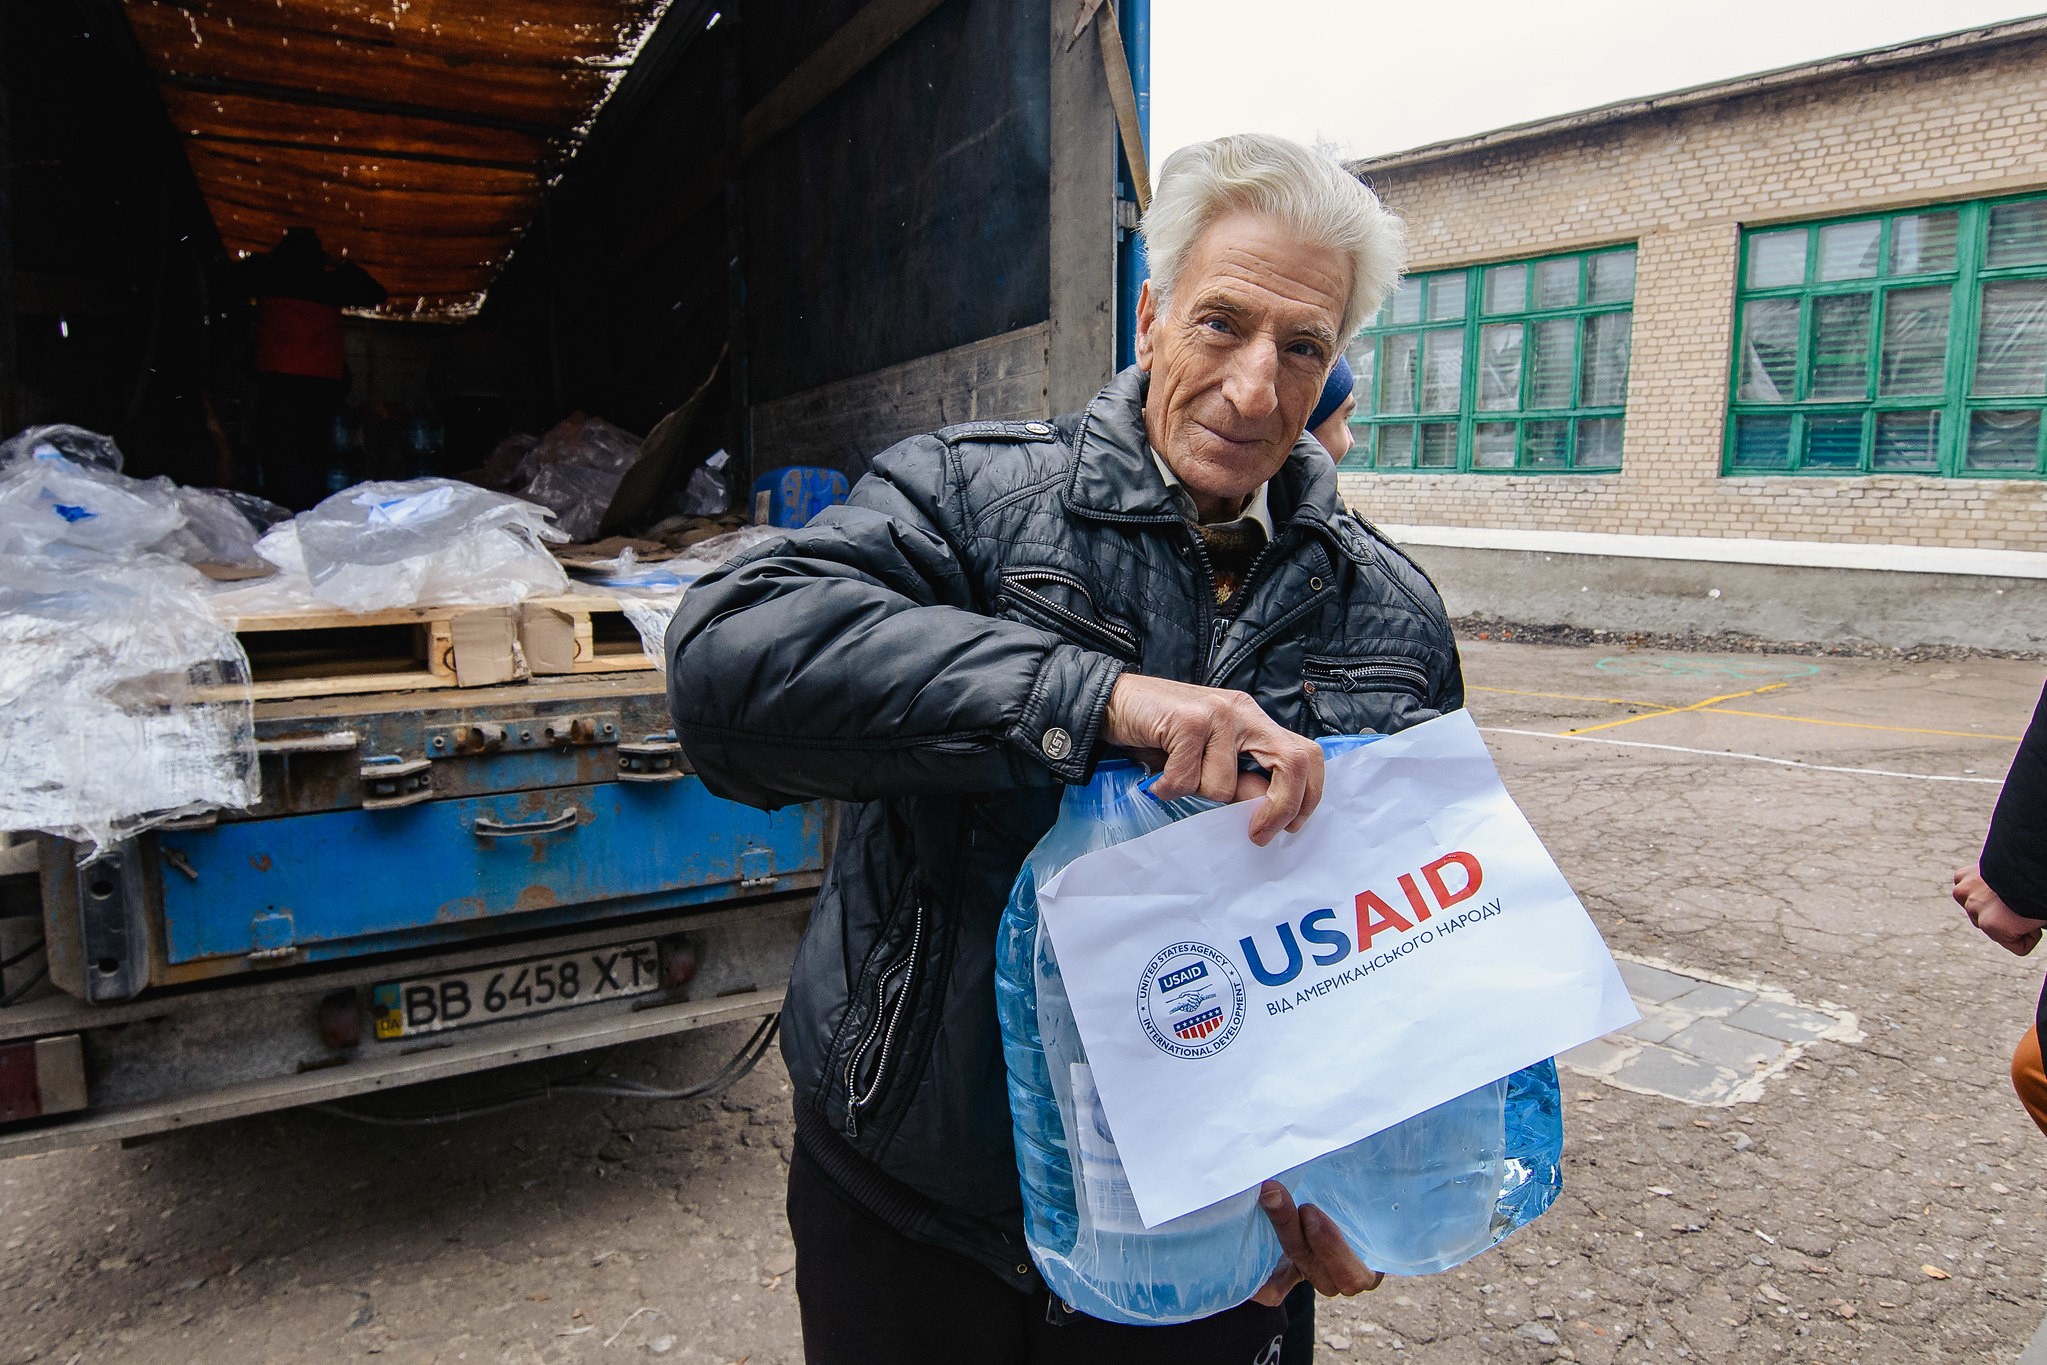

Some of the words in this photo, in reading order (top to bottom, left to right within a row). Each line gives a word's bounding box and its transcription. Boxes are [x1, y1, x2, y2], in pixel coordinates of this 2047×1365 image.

[1048, 730, 1066, 757] KST
[1239, 851, 1484, 987] USAID
[1139, 961, 1159, 999] UNITED
[1157, 944, 1189, 963] STATES
[1190, 944, 1228, 967] AGENCY
[1163, 966, 1202, 988] USAID
[1266, 997, 1294, 1016] ВІД
[1296, 931, 1434, 1006] АМЕРИКАНСЬКОГО
[1436, 898, 1502, 937] НАРОДУ
[484, 960, 580, 1013] 6458
[1143, 1018, 1213, 1057] INTERNATIONAL
[1213, 982, 1244, 1051] DEVELOPMENT
